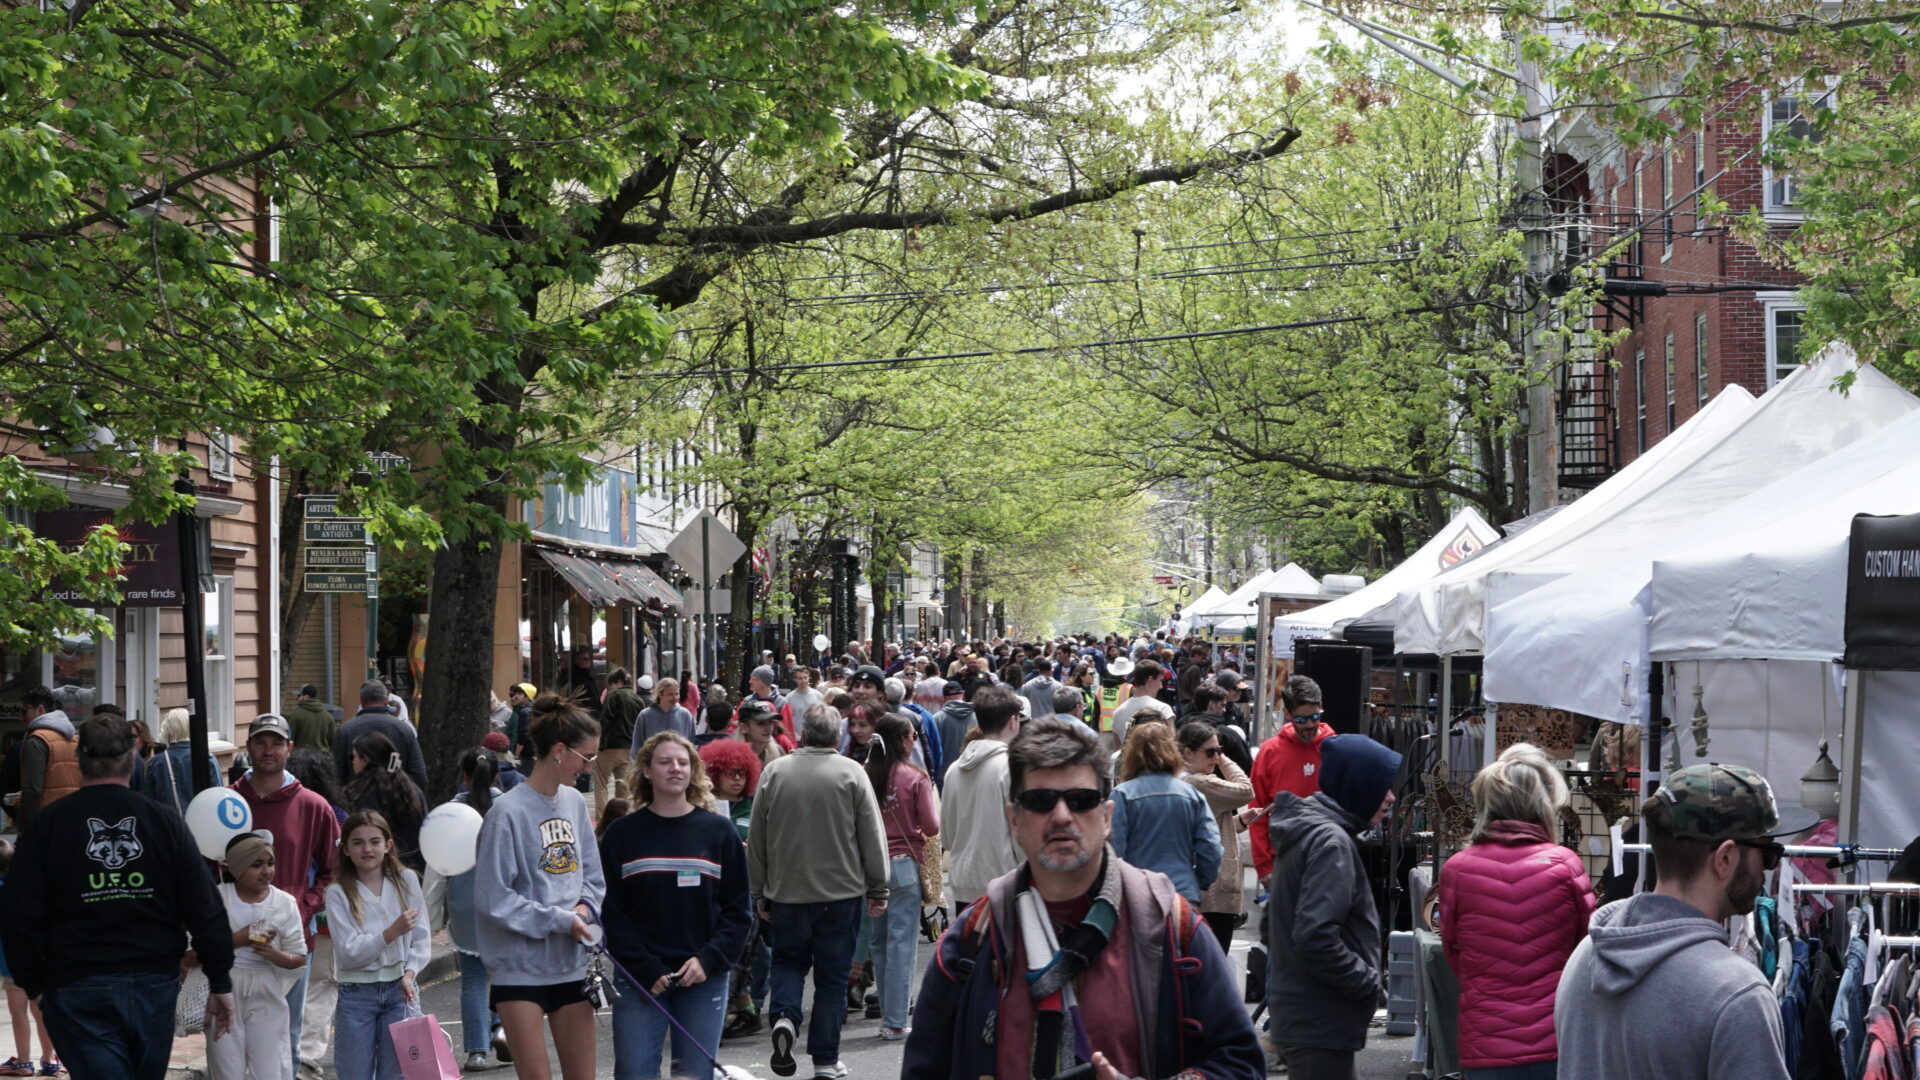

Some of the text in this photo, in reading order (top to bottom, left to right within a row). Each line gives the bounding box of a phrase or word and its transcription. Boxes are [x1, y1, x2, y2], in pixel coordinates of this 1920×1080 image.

[309, 556, 339, 564] BUDDHIST
[341, 556, 365, 564] CENTER
[1865, 550, 1900, 577] CUSTOM
[328, 575, 346, 583] FLORA
[128, 590, 148, 599] rare
[150, 588, 176, 599] finds
[540, 819, 576, 849] NHS
[89, 872, 144, 889] U.F.O
